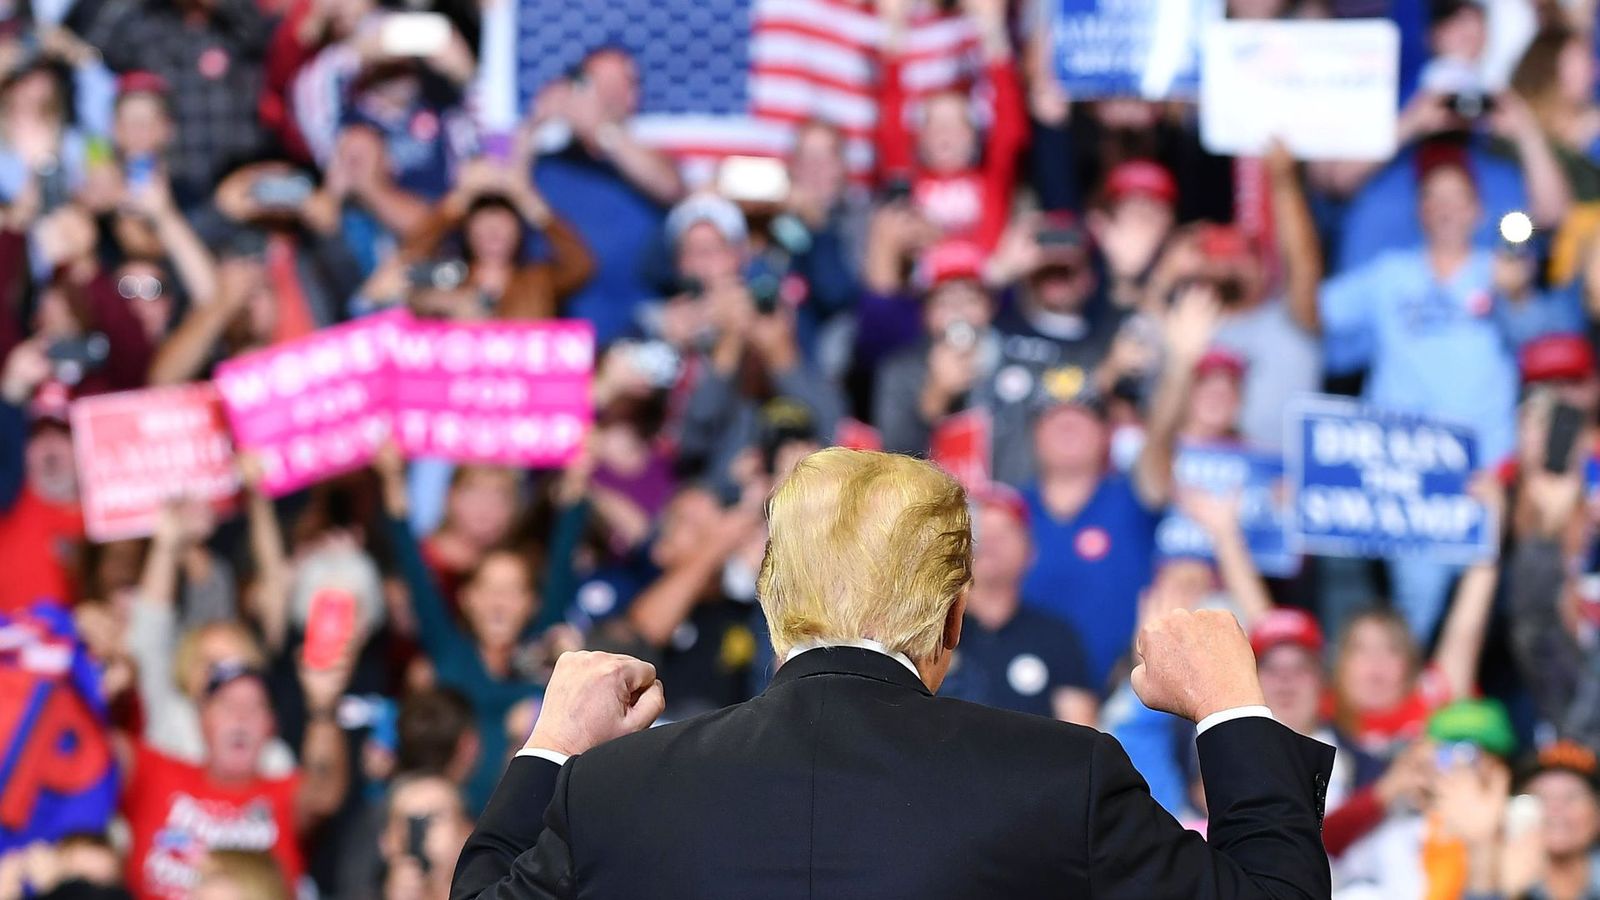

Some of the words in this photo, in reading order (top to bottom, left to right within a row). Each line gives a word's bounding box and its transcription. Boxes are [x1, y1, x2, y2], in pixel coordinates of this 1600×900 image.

[396, 329, 593, 374] WOMEN
[447, 376, 530, 408] FOR
[259, 413, 393, 486] TRUM
[398, 410, 584, 458] TRUMP
[1311, 420, 1469, 473] DRAIN
[1300, 484, 1482, 543] SWAMP
